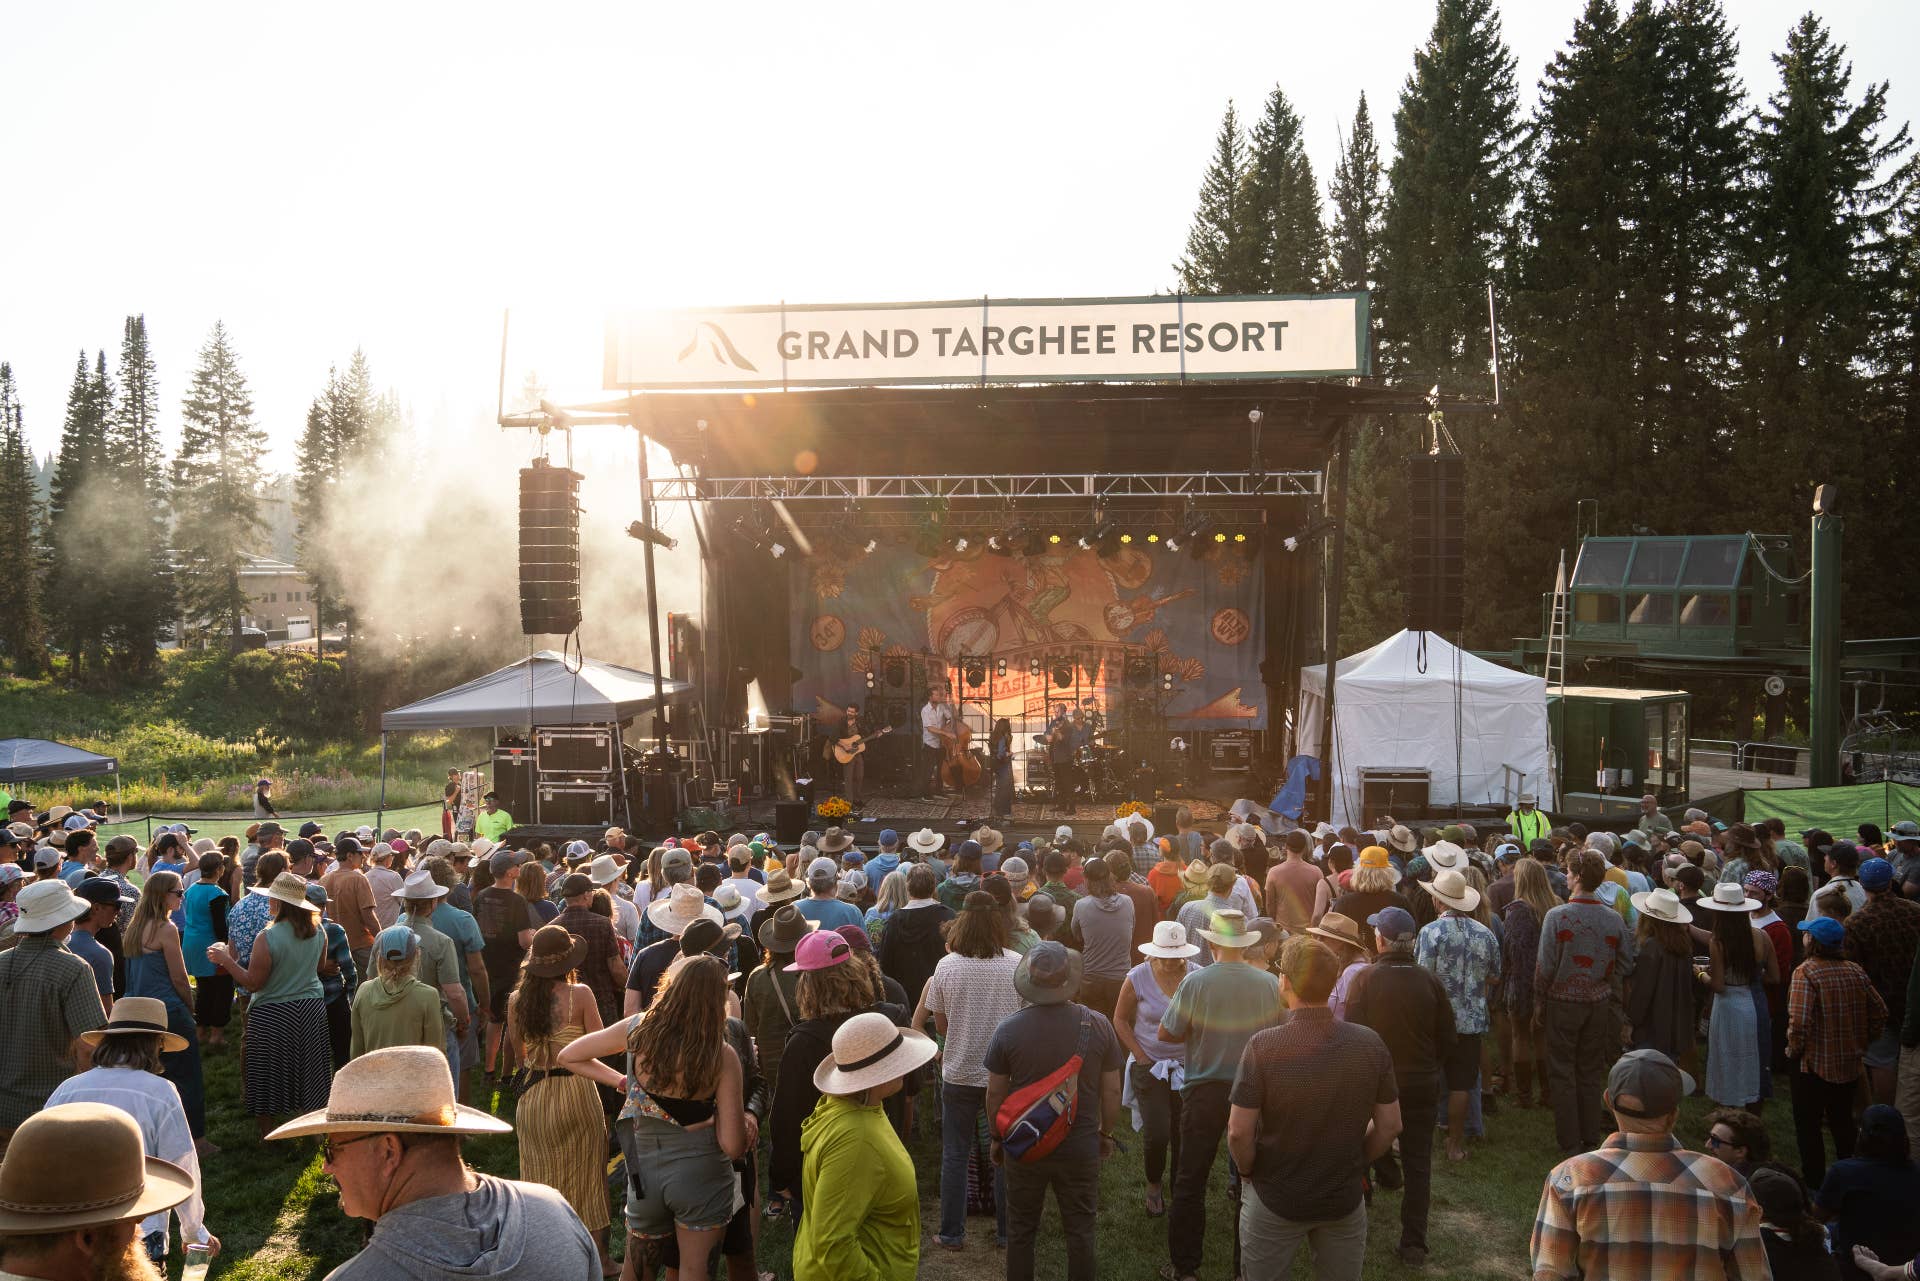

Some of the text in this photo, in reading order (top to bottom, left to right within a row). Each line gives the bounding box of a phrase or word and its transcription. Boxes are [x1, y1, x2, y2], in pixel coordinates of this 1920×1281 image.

[777, 320, 1289, 361] GRAND TARGHEE RESORT
